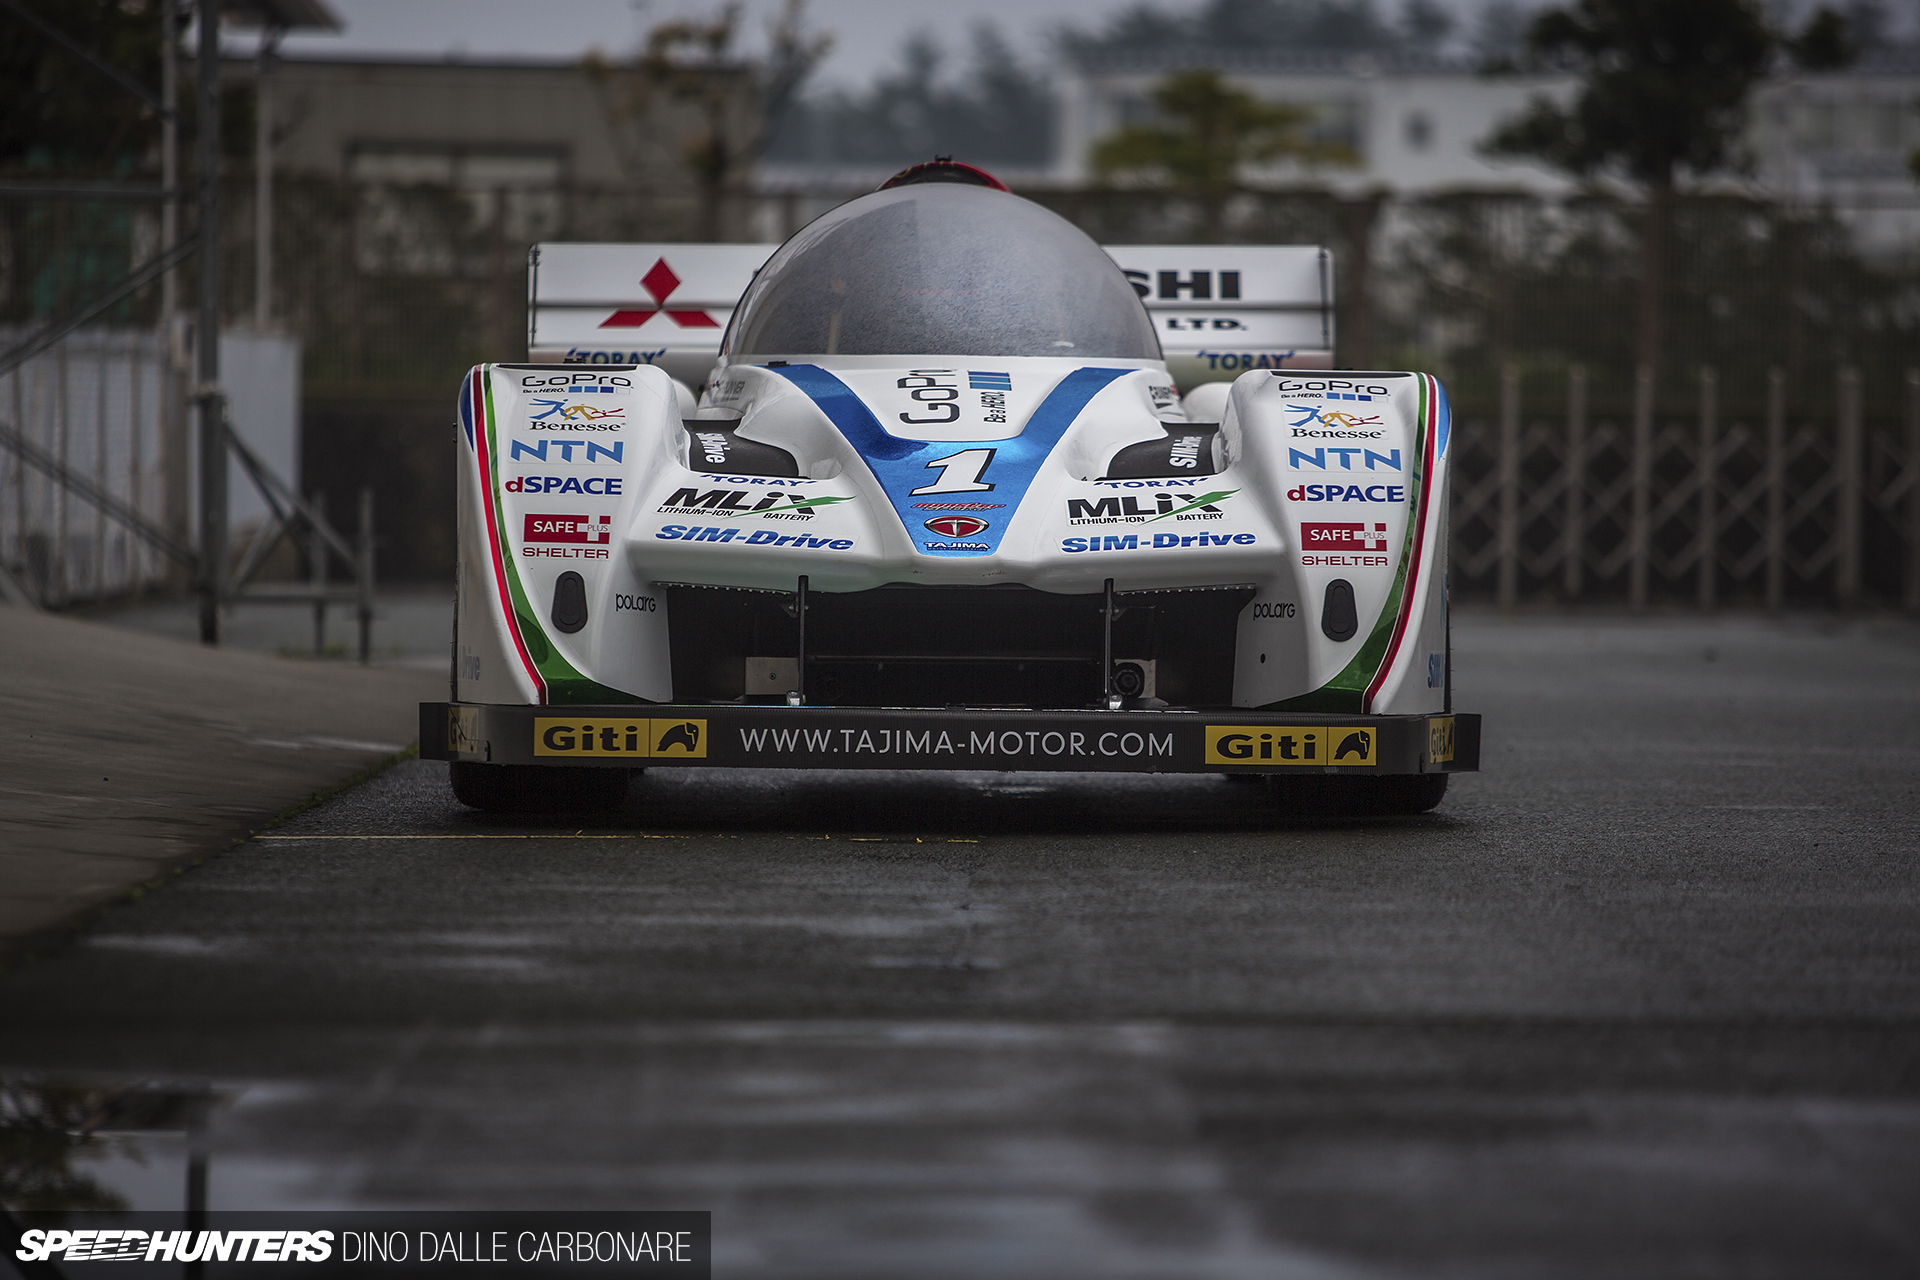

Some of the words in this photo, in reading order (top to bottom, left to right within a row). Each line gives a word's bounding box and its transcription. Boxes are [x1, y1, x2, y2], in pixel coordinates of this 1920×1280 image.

[1166, 318, 1247, 330] LTD.
[522, 373, 632, 387] GoPro
[1279, 380, 1388, 395] GoPro
[529, 421, 621, 432] Benesse
[1291, 428, 1382, 439] Benesse
[510, 439, 624, 464] NTN
[1288, 447, 1402, 471] NTN
[908, 448, 997, 497] 1
[505, 476, 622, 495] dSPACE
[1287, 484, 1405, 502] dSPACE
[657, 507, 734, 517] LITHIUM-ION
[763, 512, 814, 522] BATTERY
[1070, 516, 1145, 526] LITHIUM-ION
[1176, 513, 1224, 521] BATTERY
[533, 521, 574, 533] SAFE
[587, 524, 608, 532] PLUS
[655, 524, 854, 550] SIM-Drive
[1061, 531, 1256, 553] SIM-Drive
[1310, 529, 1350, 541] SAFE
[1364, 532, 1385, 540] PLUS
[522, 547, 609, 559] SHELTER
[1301, 556, 1388, 566] SHELTER
[543, 725, 637, 752] Giti
[739, 728, 1174, 757] WWW.TAJIMA-MOTOR.COM
[1216, 733, 1316, 760] Giti
